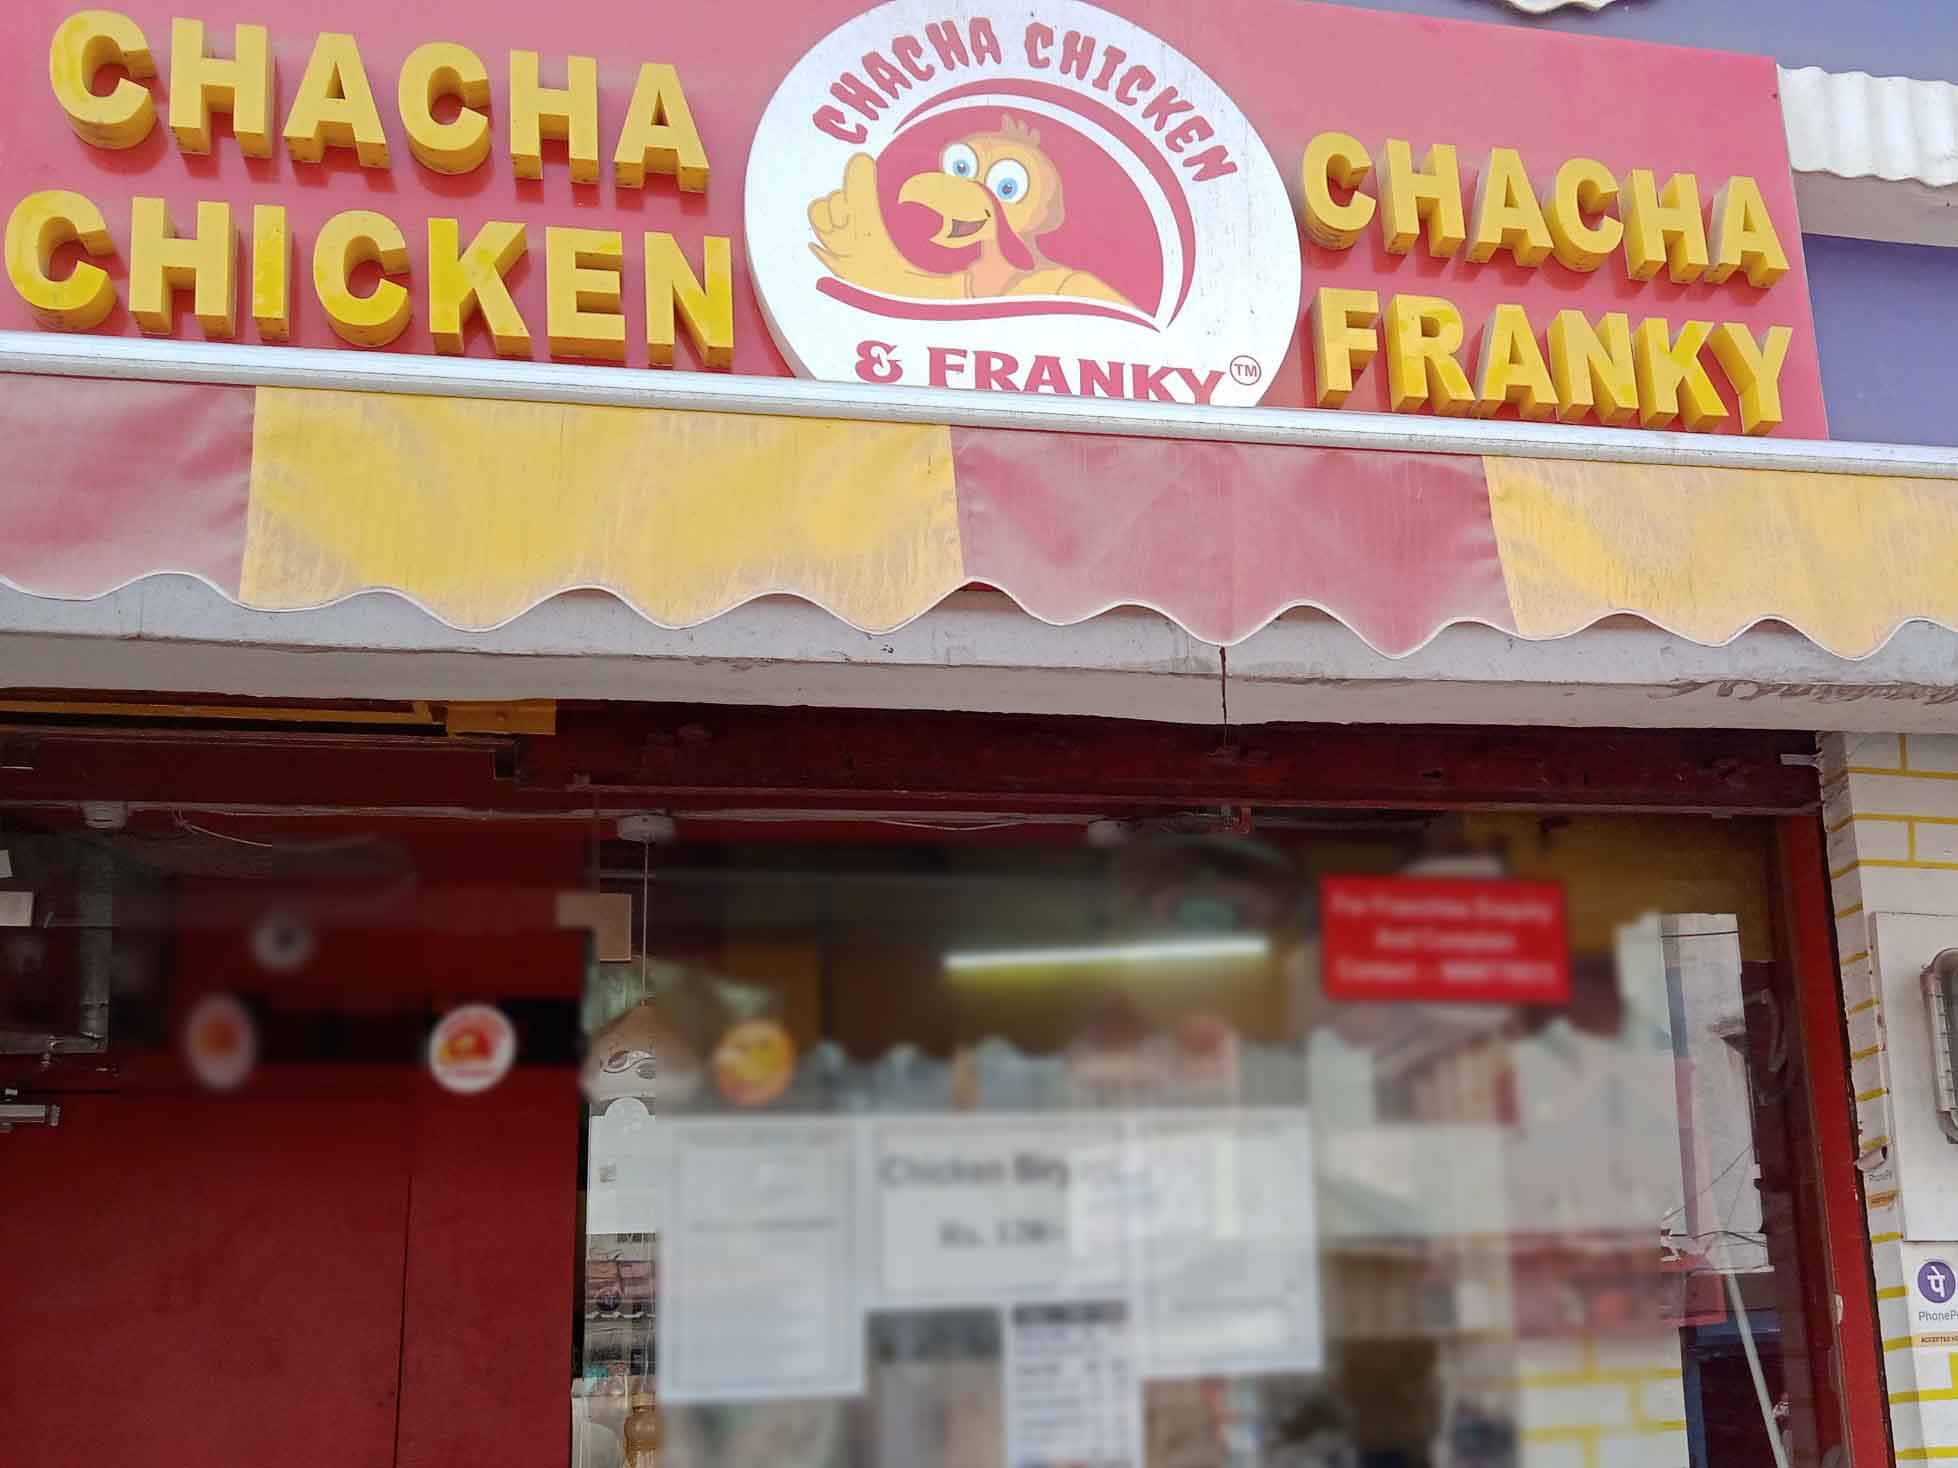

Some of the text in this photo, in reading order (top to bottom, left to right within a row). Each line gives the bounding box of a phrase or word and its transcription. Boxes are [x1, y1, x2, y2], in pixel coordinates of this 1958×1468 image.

[49, 9, 710, 193] CHACHA
[812, 17, 1239, 184] CHACHA CHICKEN
[5, 190, 735, 369] CHICKEN
[1302, 131, 1790, 288] CHACHA
[855, 340, 904, 384] &
[926, 345, 1227, 405] FRANKY
[1311, 287, 1793, 436] FRANKY
[1918, 1309, 1958, 1321] PhoneP
